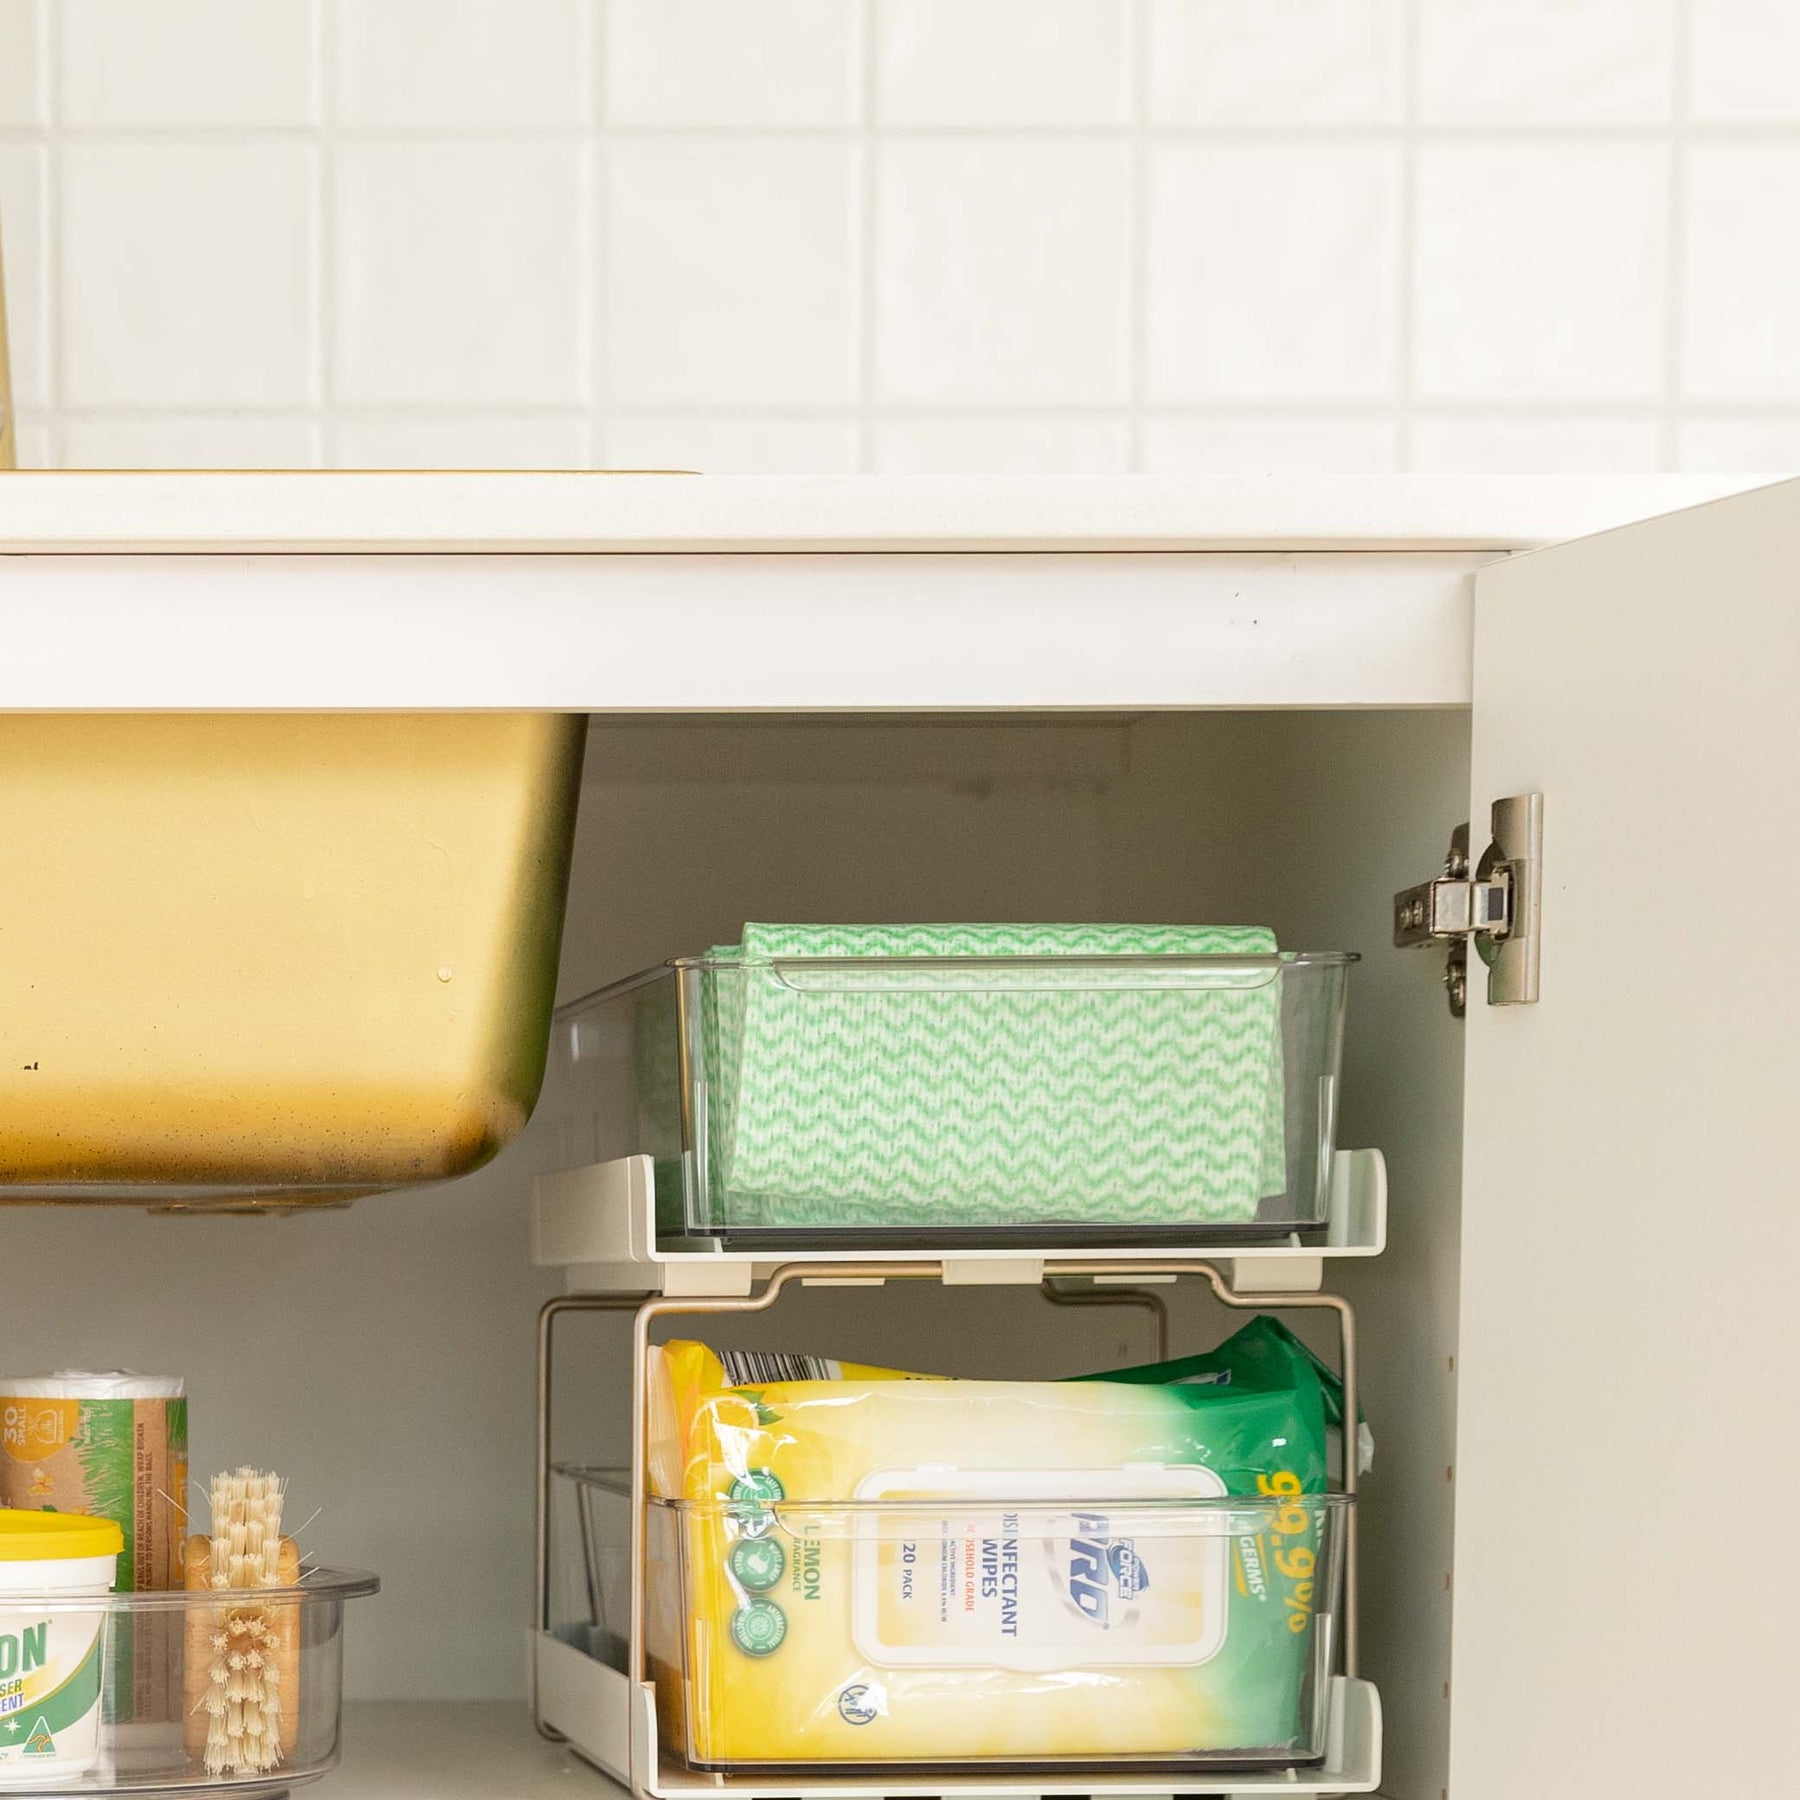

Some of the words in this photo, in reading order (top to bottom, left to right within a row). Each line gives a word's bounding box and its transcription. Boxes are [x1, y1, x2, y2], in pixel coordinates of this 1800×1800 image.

[4, 1406, 18, 1444] 30
[17, 1405, 27, 1447] SMALL
[792, 1537, 801, 1592] RAGRANCE
[804, 1526, 820, 1601] LEMON
[903, 1543, 916, 1563] 20
[981, 1538, 998, 1598] WIPES
[1118, 1537, 1134, 1600] FORCE
[1256, 1471, 1317, 1633] 99.9%
[903, 1569, 913, 1599] PACK
[964, 1582, 975, 1612] GRADE
